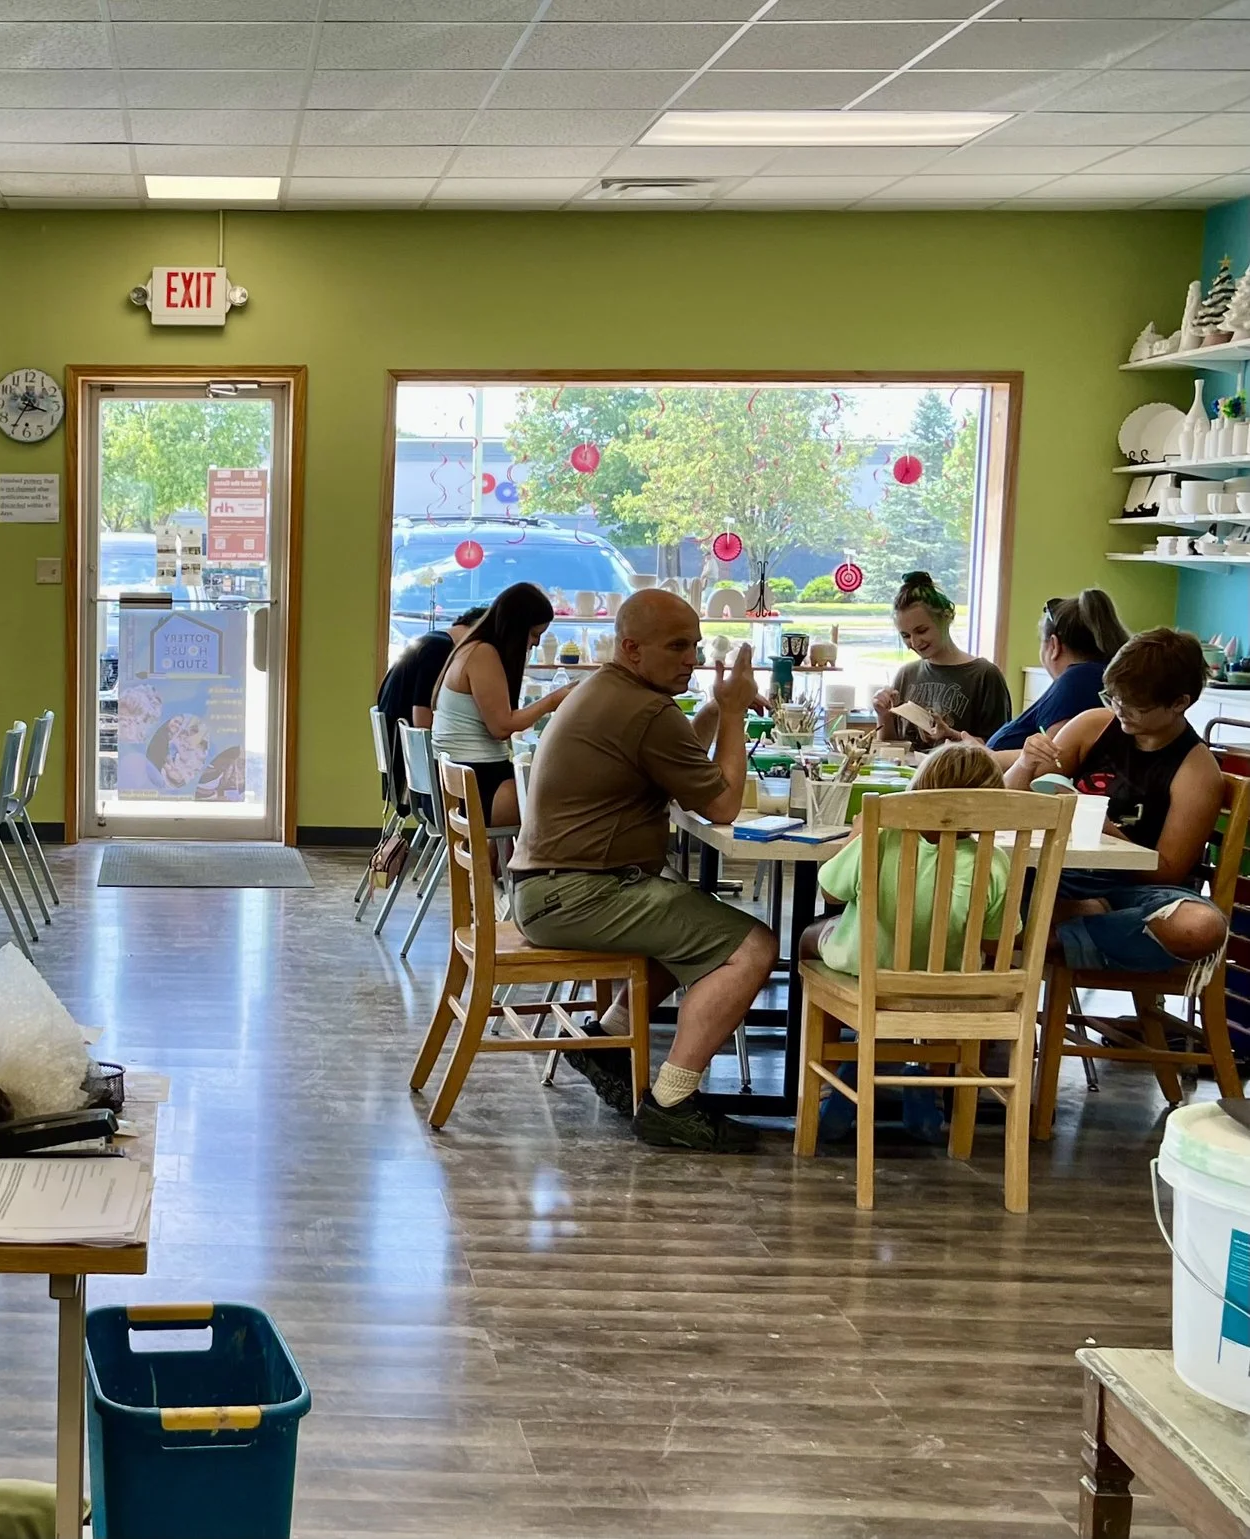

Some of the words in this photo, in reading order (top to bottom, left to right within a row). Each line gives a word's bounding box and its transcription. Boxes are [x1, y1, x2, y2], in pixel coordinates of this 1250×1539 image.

[166, 272, 216, 308] EXIT
[25, 371, 36, 383] 12
[1, 384, 12, 395] 10
[48, 386, 57, 397] 2
[51, 400, 60, 412] 3
[0, 412, 8, 423] 8
[22, 427, 31, 439] 6
[35, 425, 44, 436] 5
